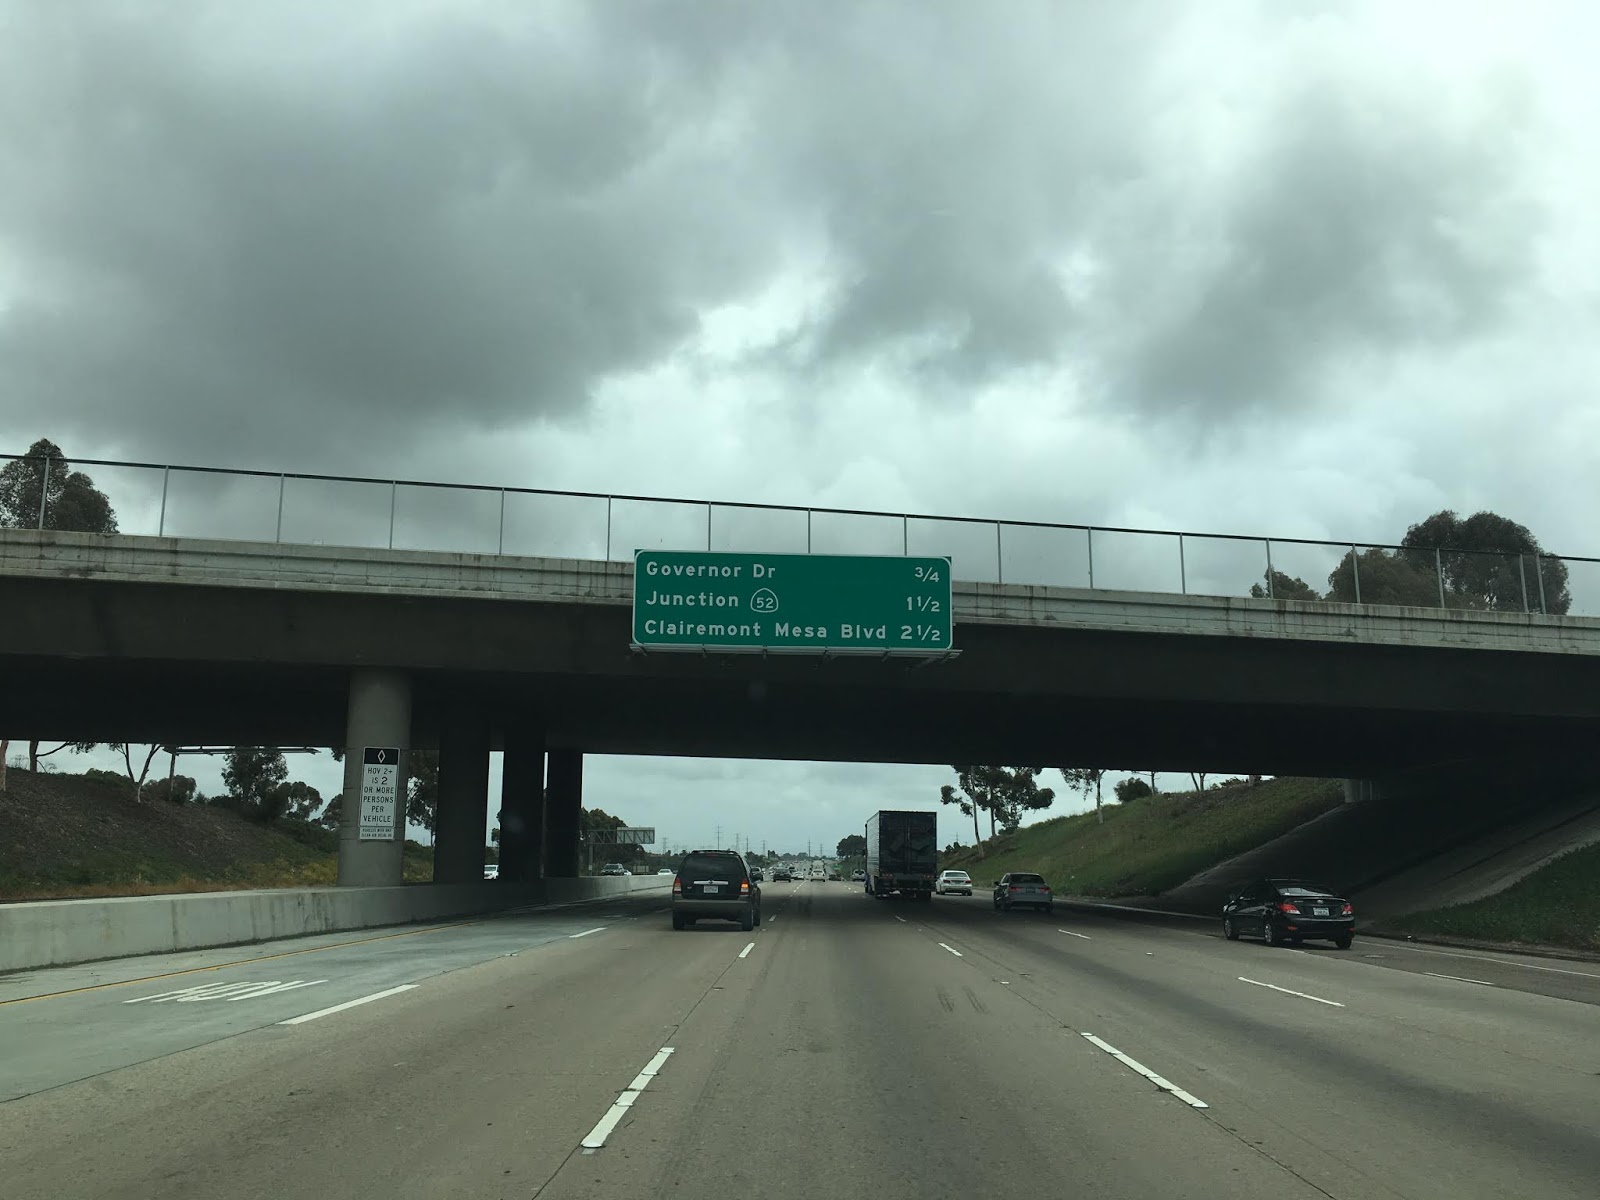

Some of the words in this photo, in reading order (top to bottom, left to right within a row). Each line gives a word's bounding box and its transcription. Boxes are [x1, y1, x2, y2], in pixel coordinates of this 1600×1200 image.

[646, 561, 742, 578] Governor
[753, 563, 776, 579] Dr
[645, 590, 739, 607] Junction
[756, 597, 774, 609] 52
[644, 619, 761, 636] Clairemont
[774, 622, 827, 638] Mesa
[840, 623, 886, 639] Blvd
[381, 776, 388, 785] 2
